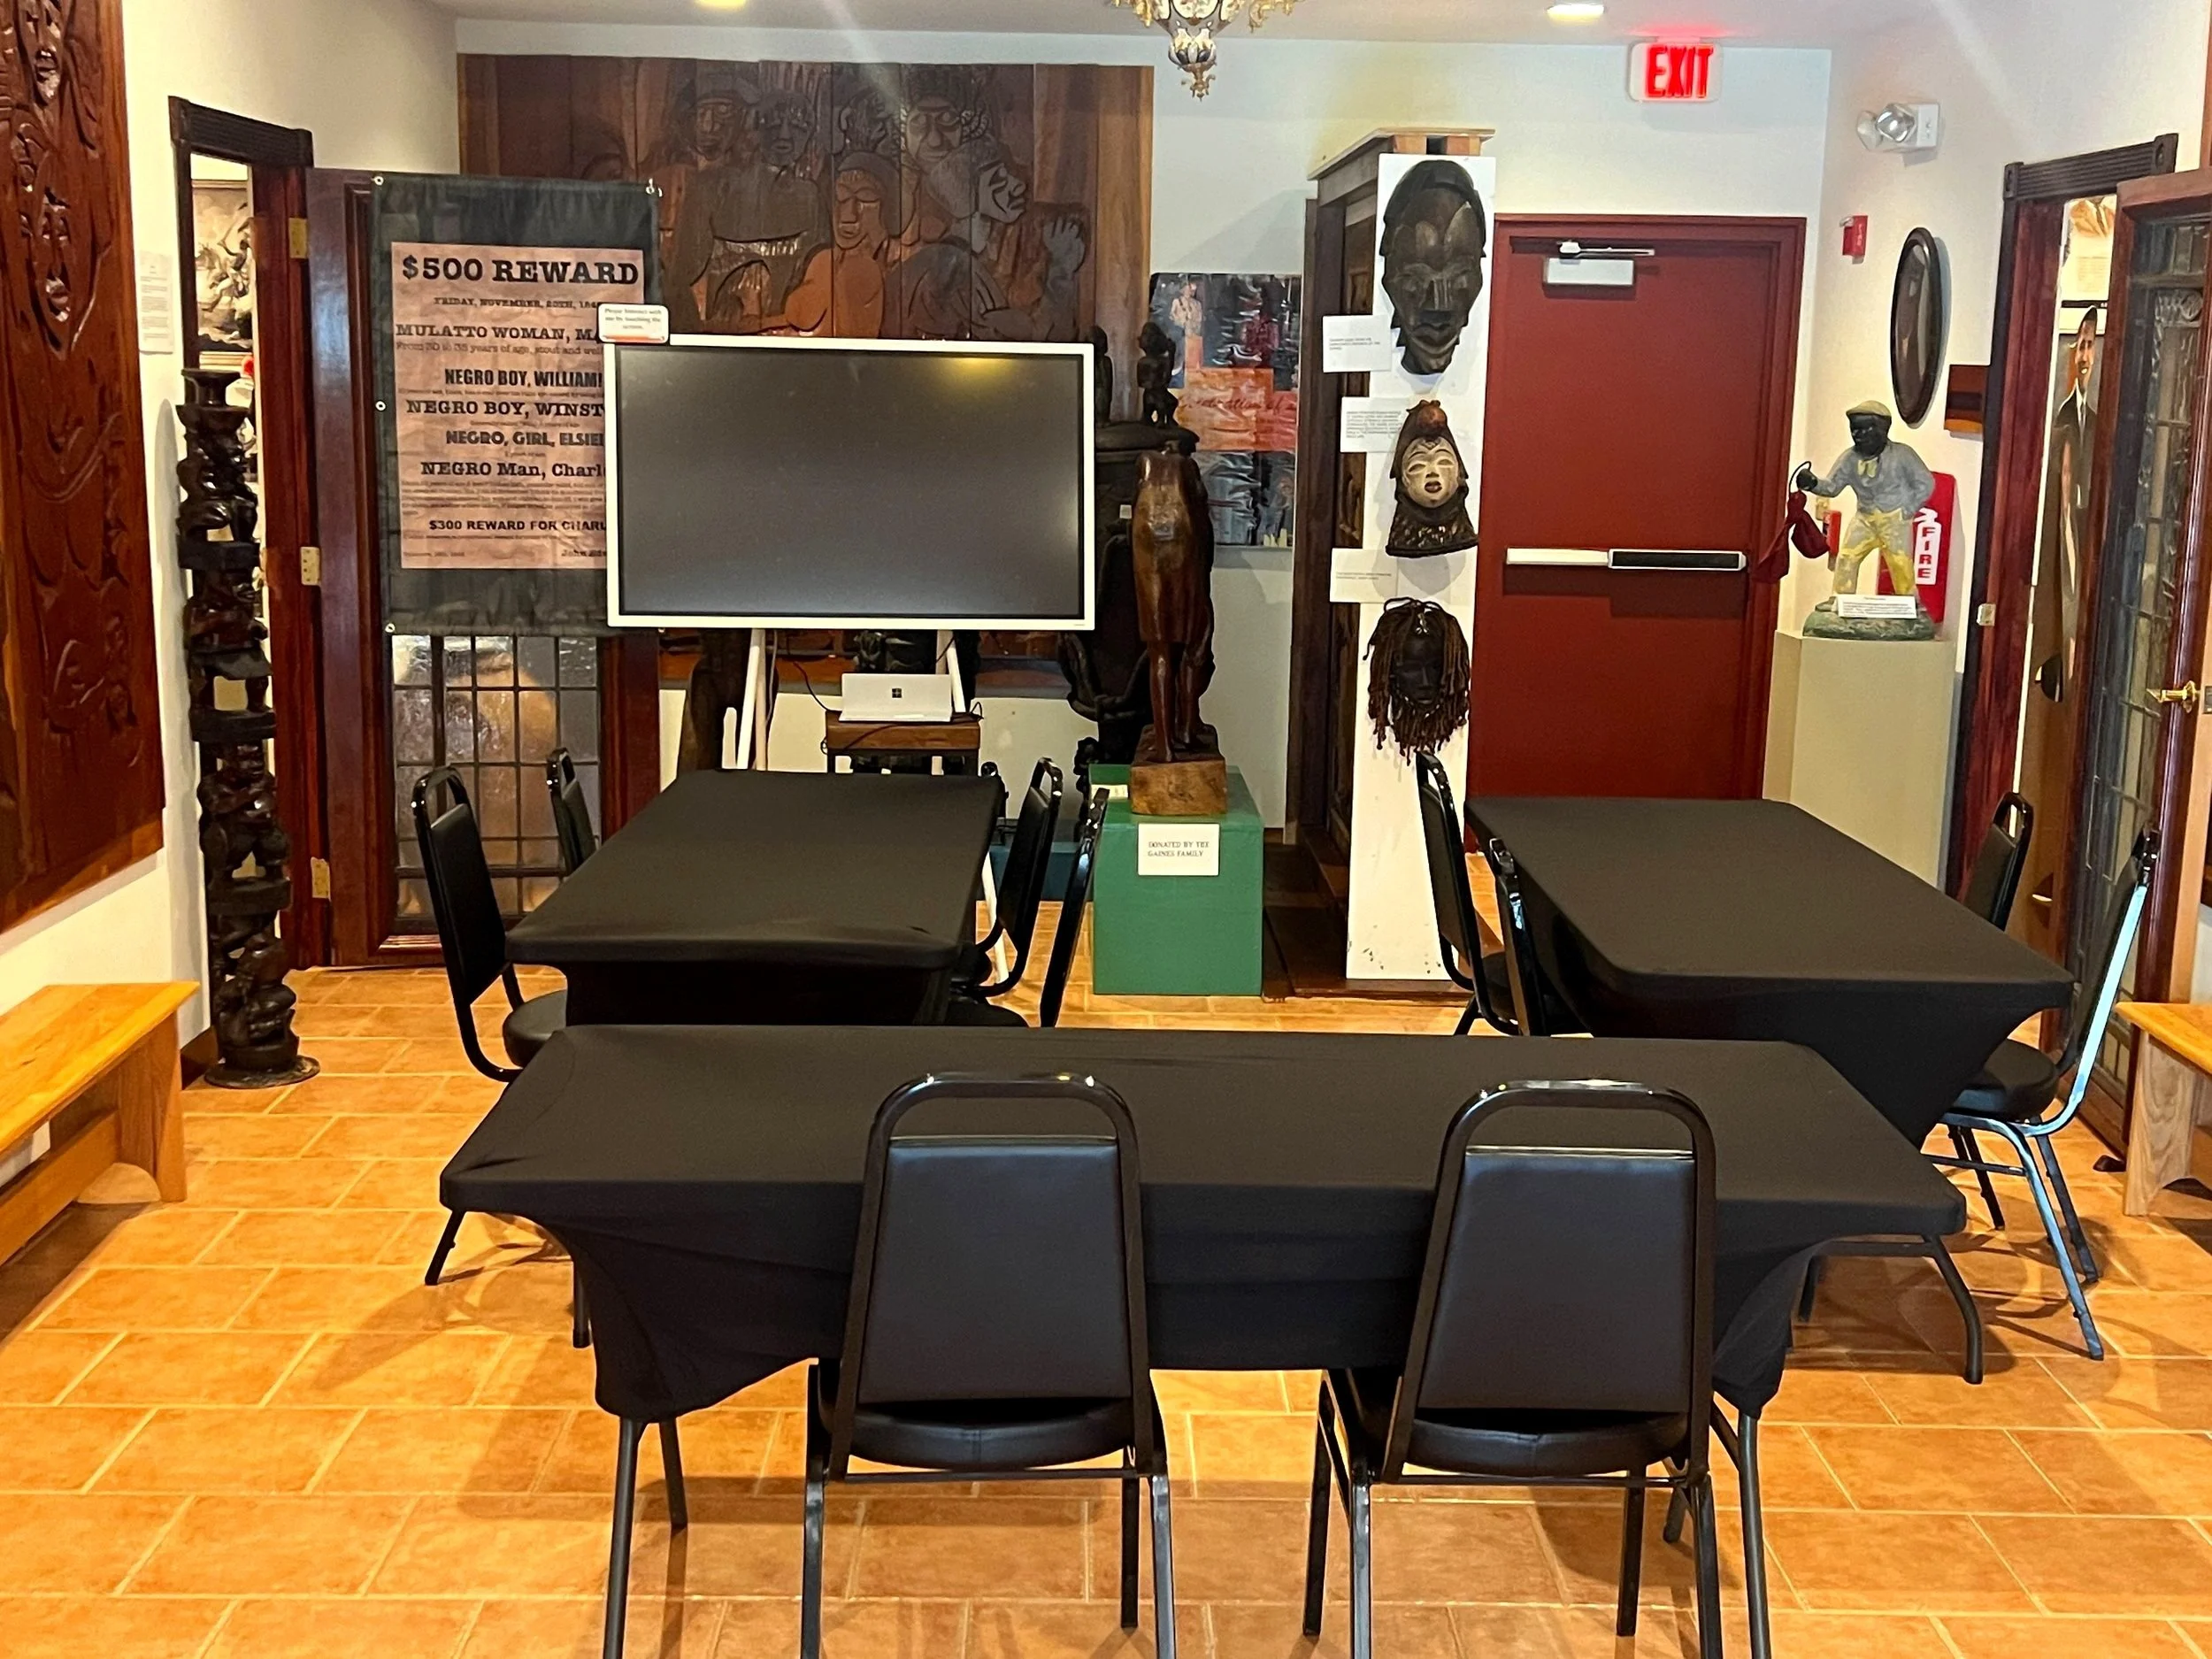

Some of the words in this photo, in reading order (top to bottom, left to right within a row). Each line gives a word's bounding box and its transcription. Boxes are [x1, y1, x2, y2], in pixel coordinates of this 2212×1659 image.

[1647, 44, 1714, 98] EXIT
[403, 254, 483, 280] $500
[492, 259, 639, 285] REWARD
[434, 296, 478, 308] FRIDAY,
[480, 298, 543, 309] NOVEMBER,
[396, 324, 488, 338] MULATTO
[491, 326, 571, 343] WOMAN,
[470, 344, 498, 354] years
[500, 344, 511, 353] of
[562, 346, 581, 355] and
[445, 368, 494, 386] NEGRO
[406, 400, 479, 415] NEGRO
[484, 401, 529, 419] BOY,
[534, 403, 604, 417] WINST
[446, 430, 509, 447] NEGRO,
[512, 431, 556, 448] GIRL,
[420, 462, 492, 476] NEGRO
[496, 463, 546, 480] Man,
[551, 464, 605, 477] Charl
[429, 520, 462, 531] $300
[466, 520, 526, 531] REWARD
[530, 520, 558, 531] FOR
[1917, 526, 1936, 579] FIRE
